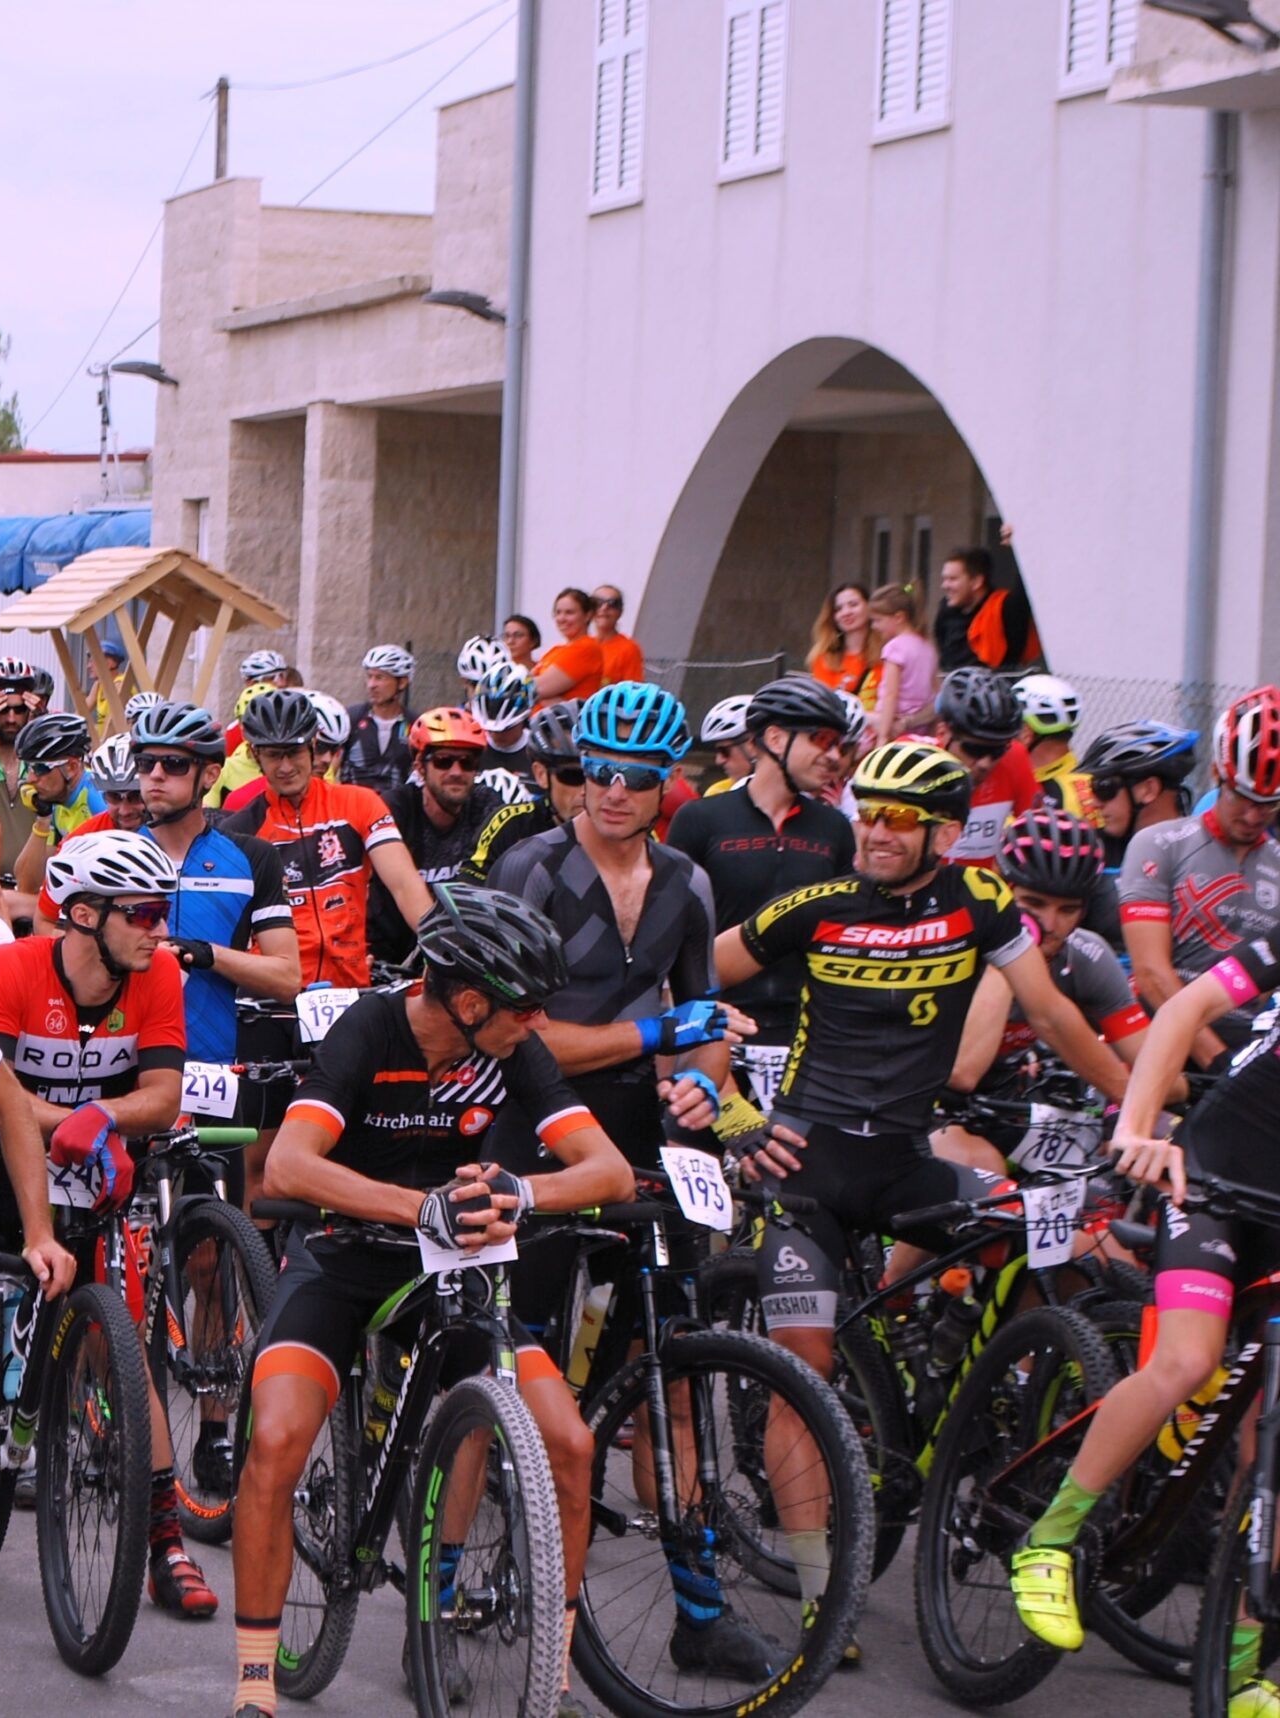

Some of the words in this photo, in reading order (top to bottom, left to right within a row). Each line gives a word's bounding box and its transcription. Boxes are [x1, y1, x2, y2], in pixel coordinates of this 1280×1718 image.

[839, 920, 948, 945] SRAM
[818, 958, 967, 982] SCOTT
[22, 1047, 132, 1068] RODA
[185, 1074, 228, 1101] 214
[1033, 1132, 1077, 1163] 187
[681, 1176, 725, 1212] 193
[1036, 1212, 1068, 1249] 20
[773, 1273, 816, 1285] odlo
